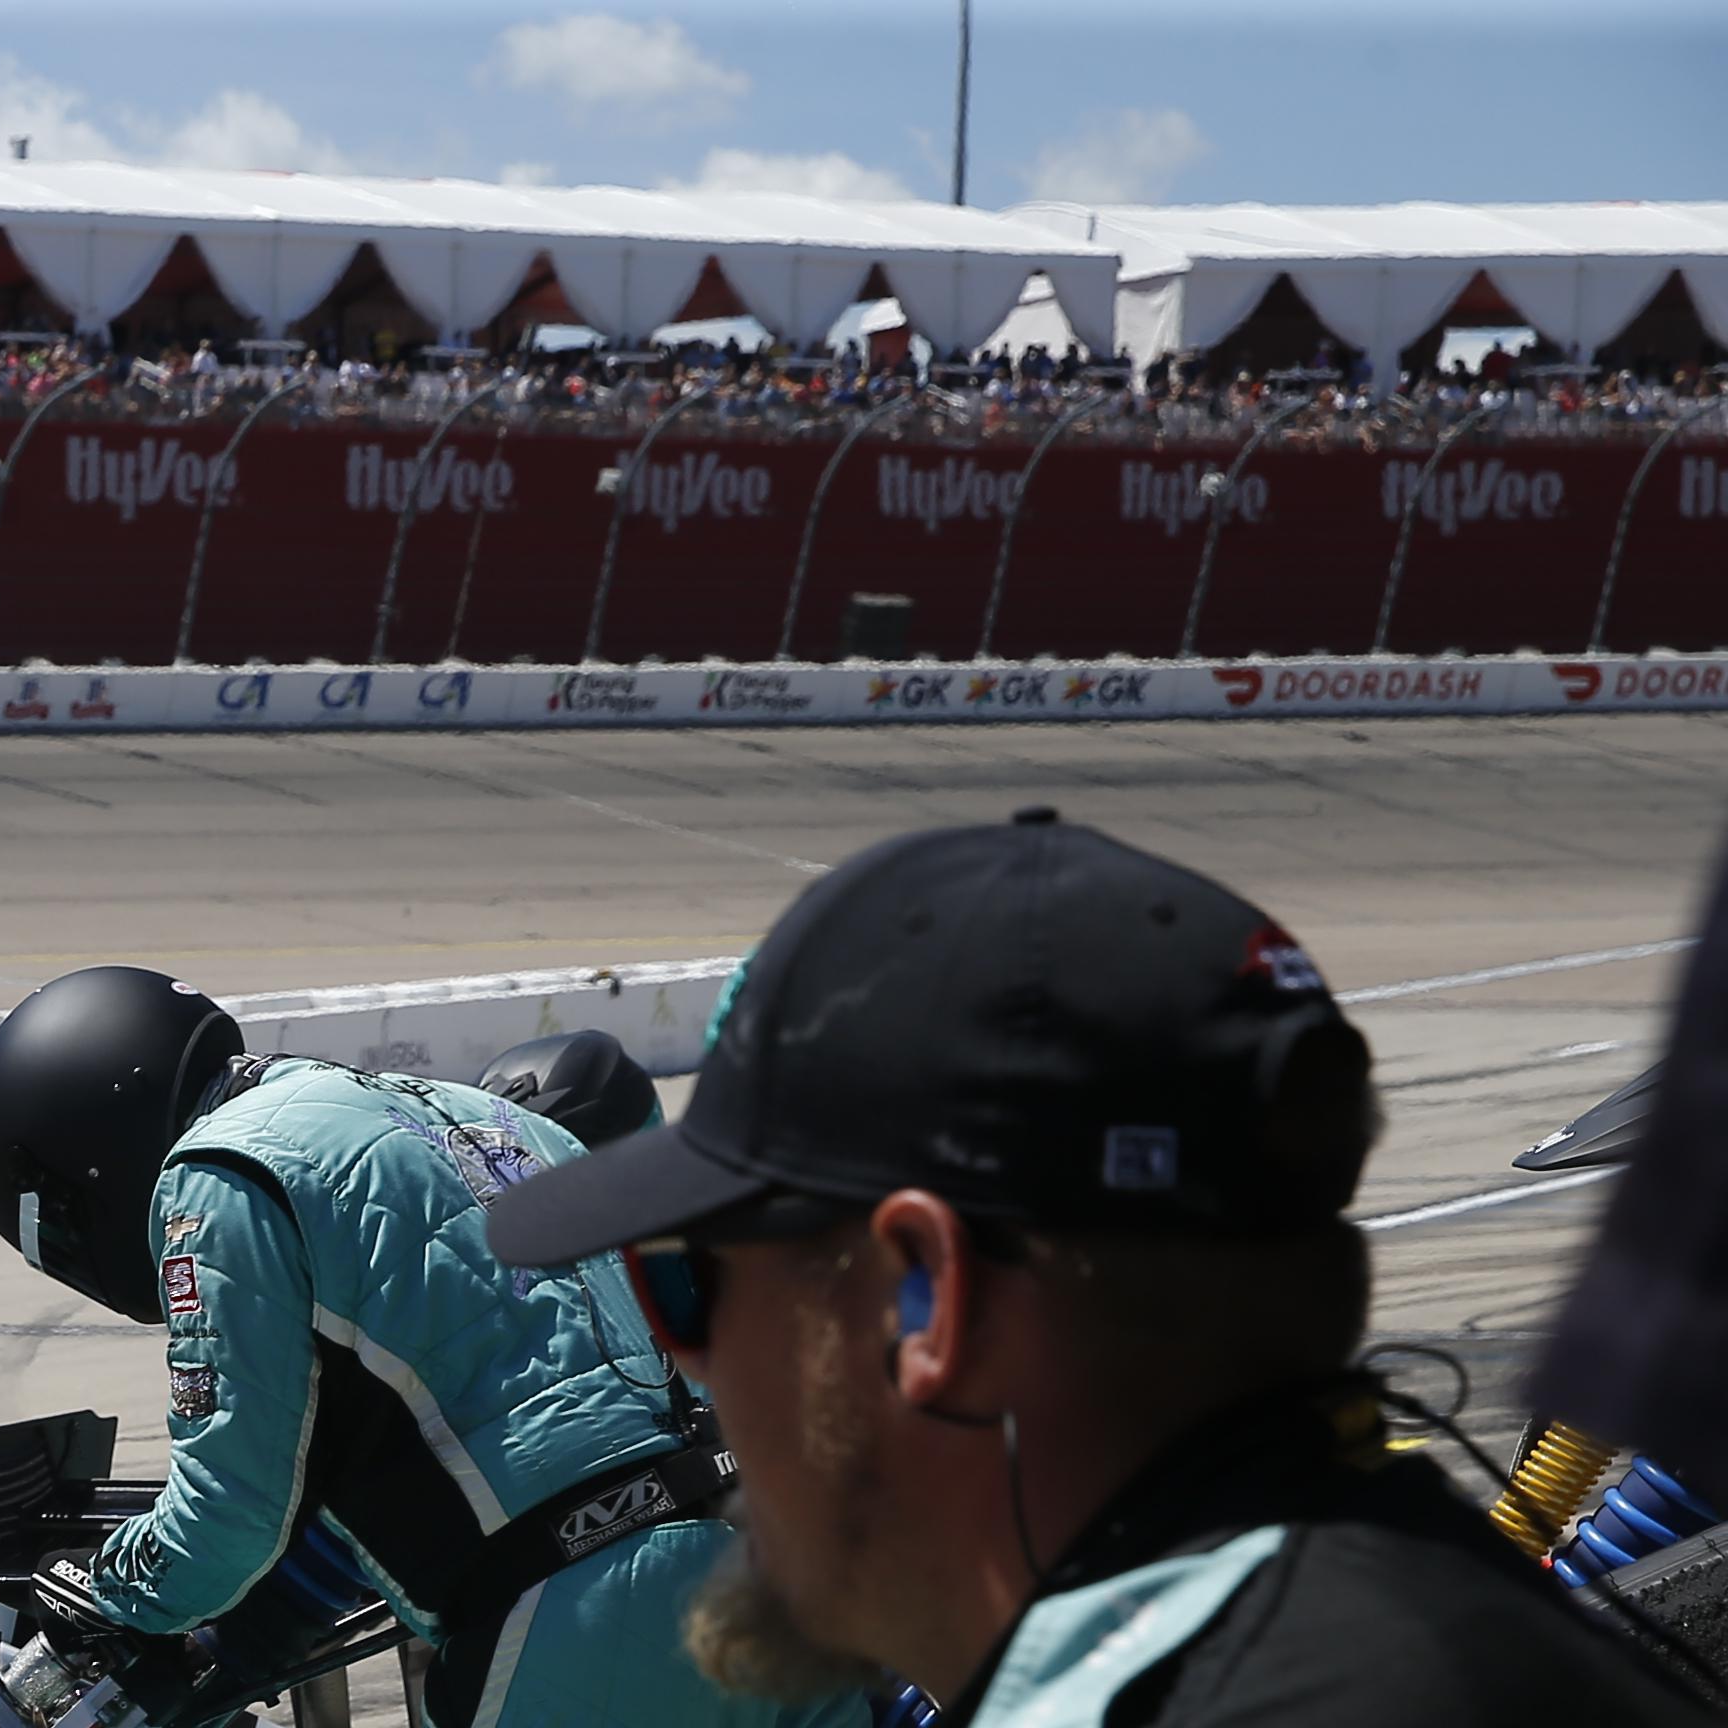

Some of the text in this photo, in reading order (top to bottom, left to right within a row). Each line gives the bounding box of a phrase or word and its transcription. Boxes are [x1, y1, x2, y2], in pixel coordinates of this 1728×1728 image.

[900, 672, 953, 708] GK
[1000, 671, 1051, 706] GK
[1097, 670, 1153, 707] GK
[1272, 668, 1484, 702] DOORDASH
[564, 1496, 672, 1557] MECHANIX WEAR
